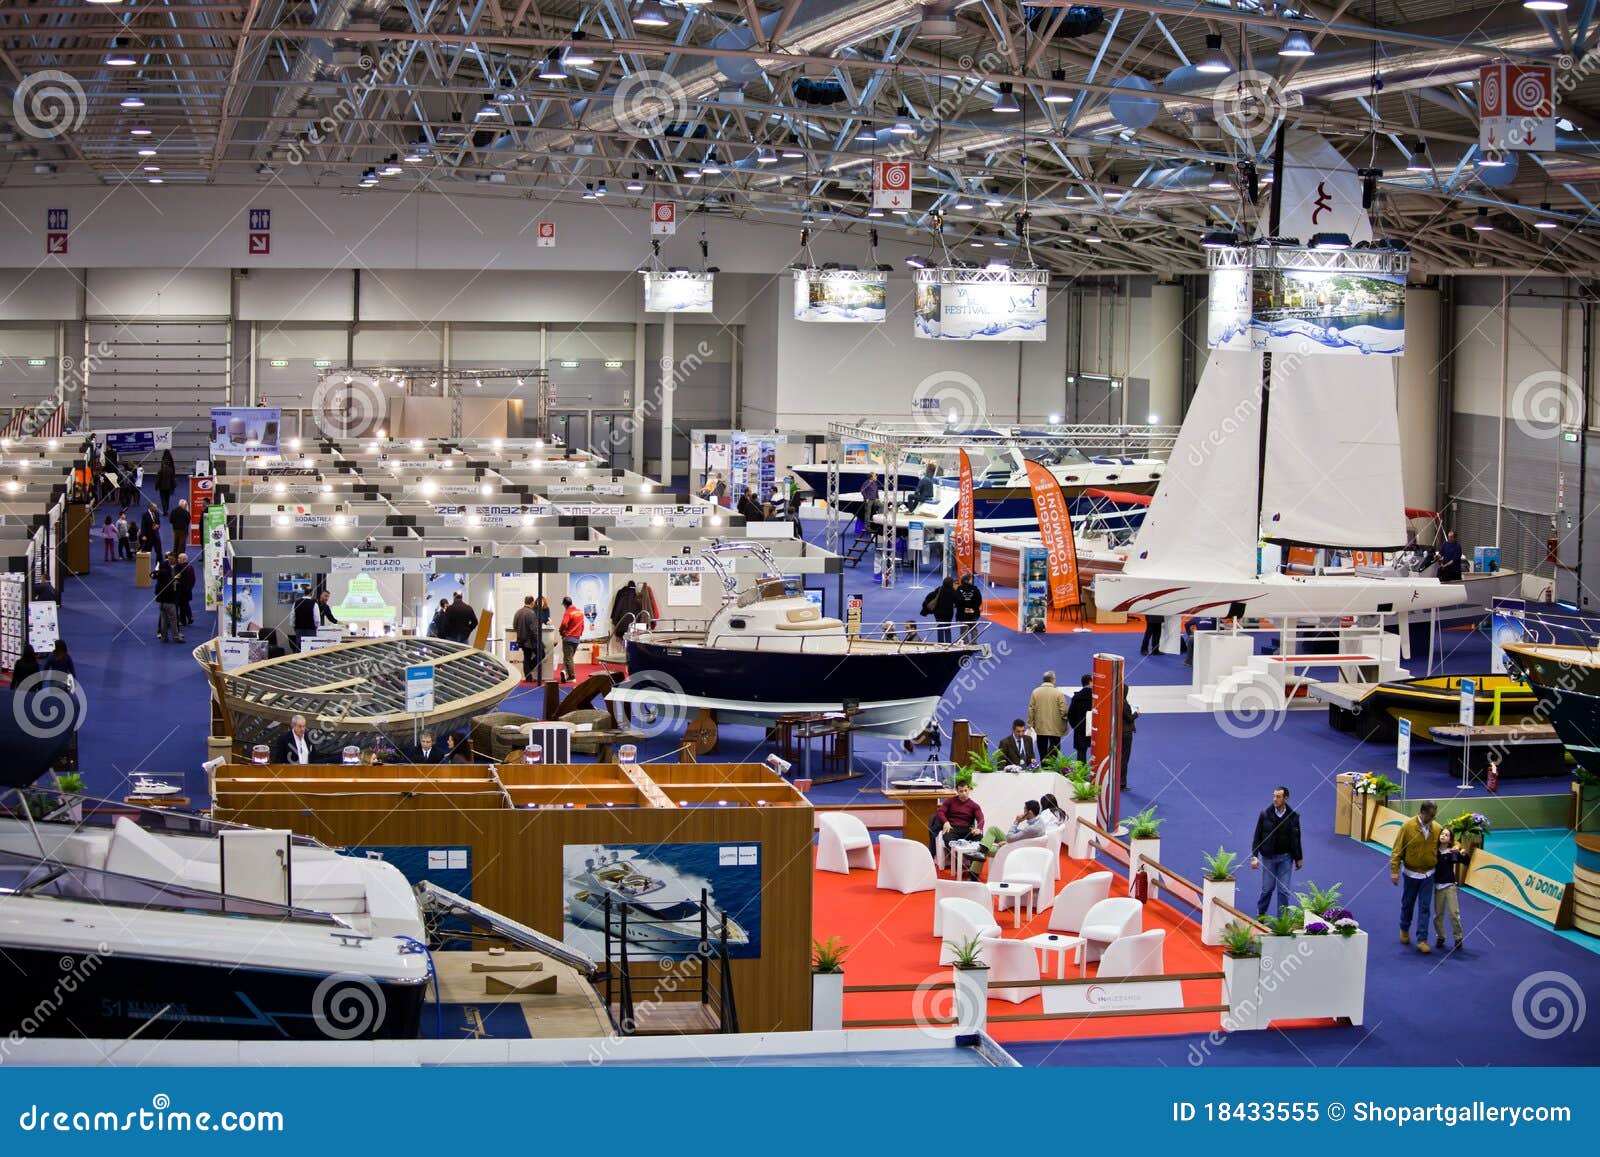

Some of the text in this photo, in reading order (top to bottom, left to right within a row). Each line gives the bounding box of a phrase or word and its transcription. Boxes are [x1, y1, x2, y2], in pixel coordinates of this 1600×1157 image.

[491, 506, 547, 515] mazer
[1037, 495, 1060, 577] NOLEGGIO
[1046, 492, 1068, 575] GOMMONI
